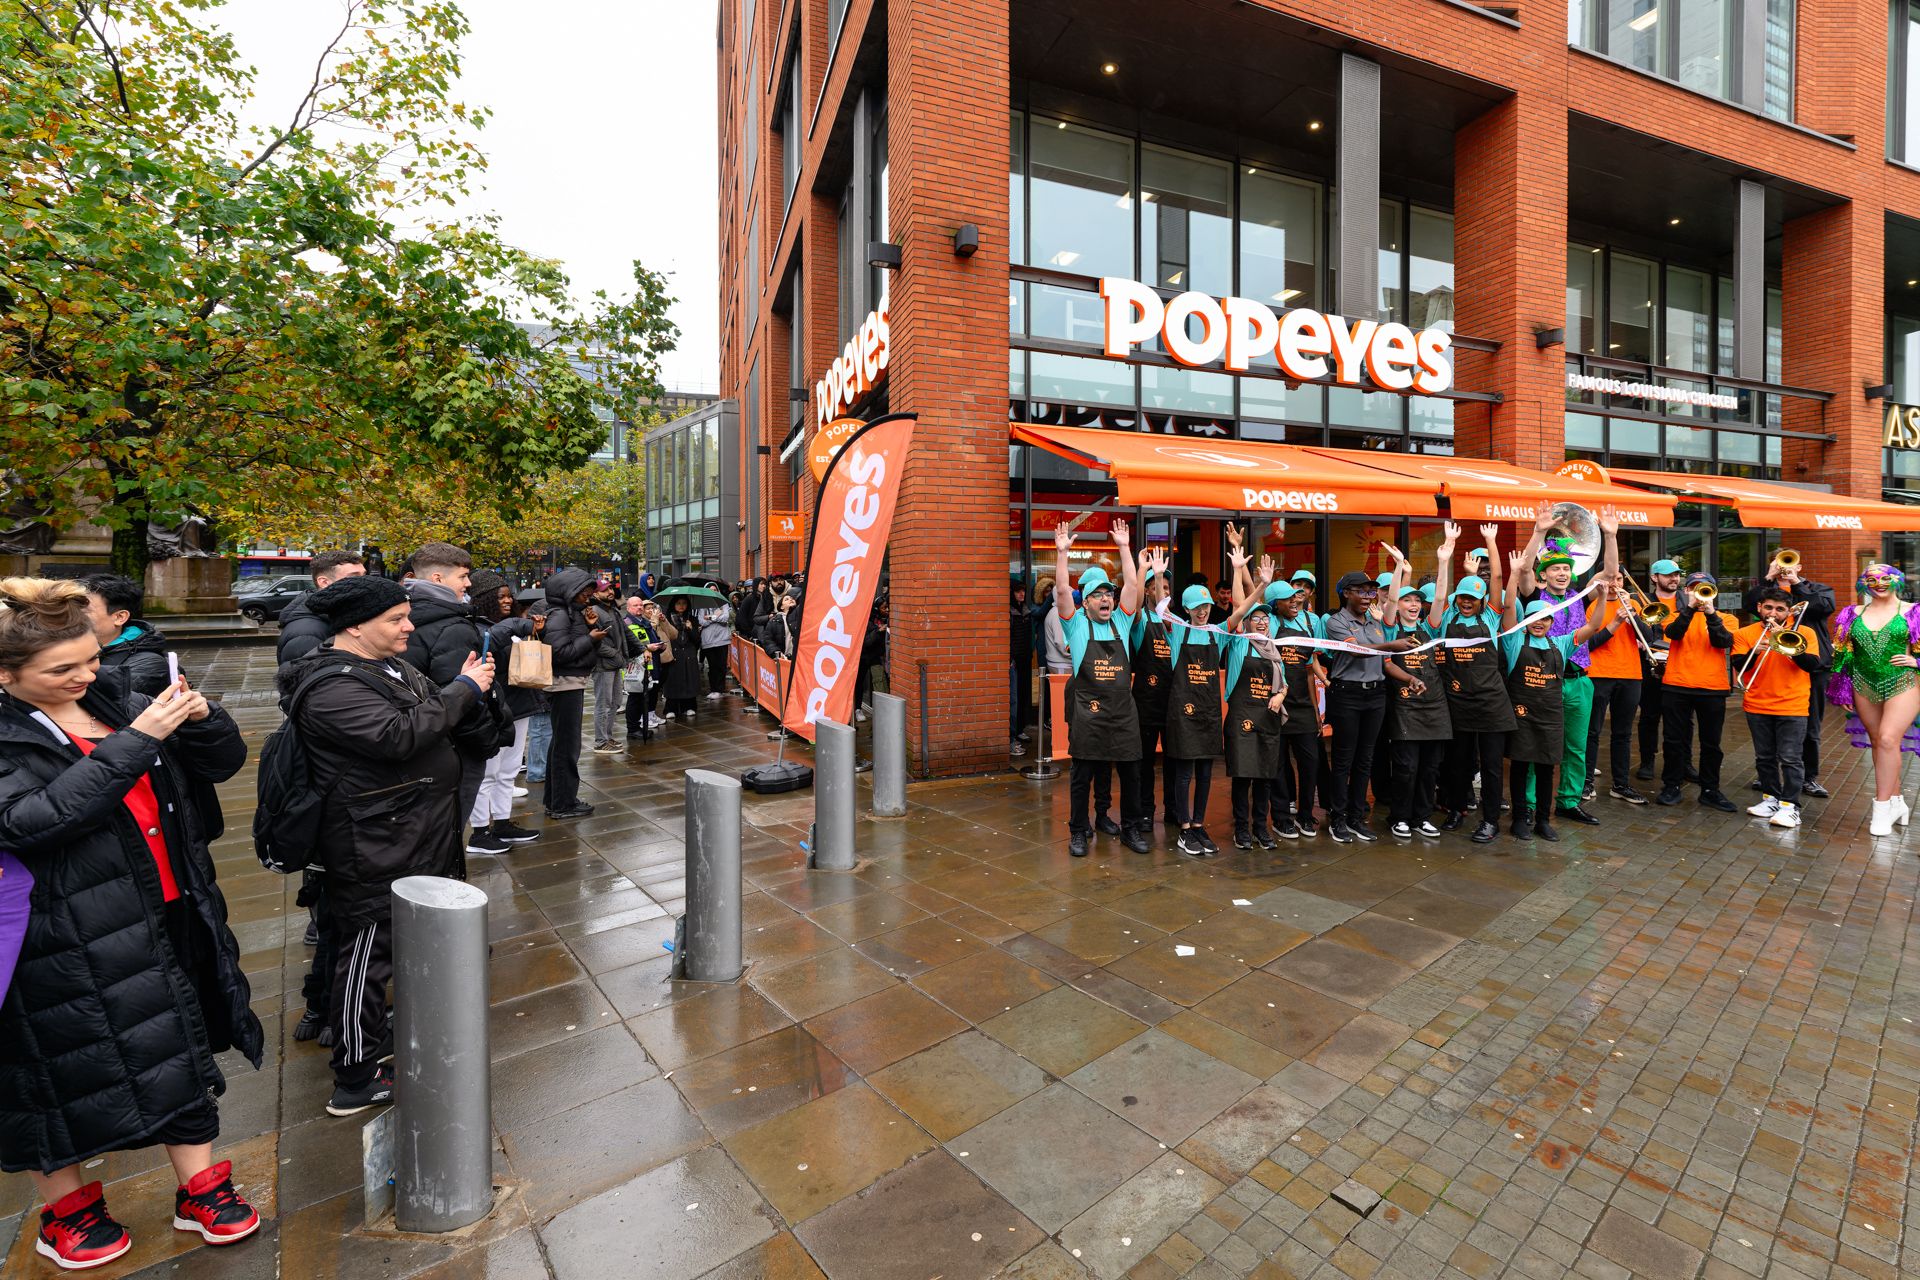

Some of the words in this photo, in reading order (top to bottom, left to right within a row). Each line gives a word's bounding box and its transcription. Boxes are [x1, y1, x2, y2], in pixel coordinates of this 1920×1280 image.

[1568, 373, 1621, 394] FAMOUS
[1621, 381, 1688, 402] LOUISIANA
[1688, 391, 1738, 410] CHICKEN
[1485, 503, 1536, 520] FAMOUS
[1524, 671, 1557, 680] CRUNCH
[1524, 677, 1546, 685] TIME
